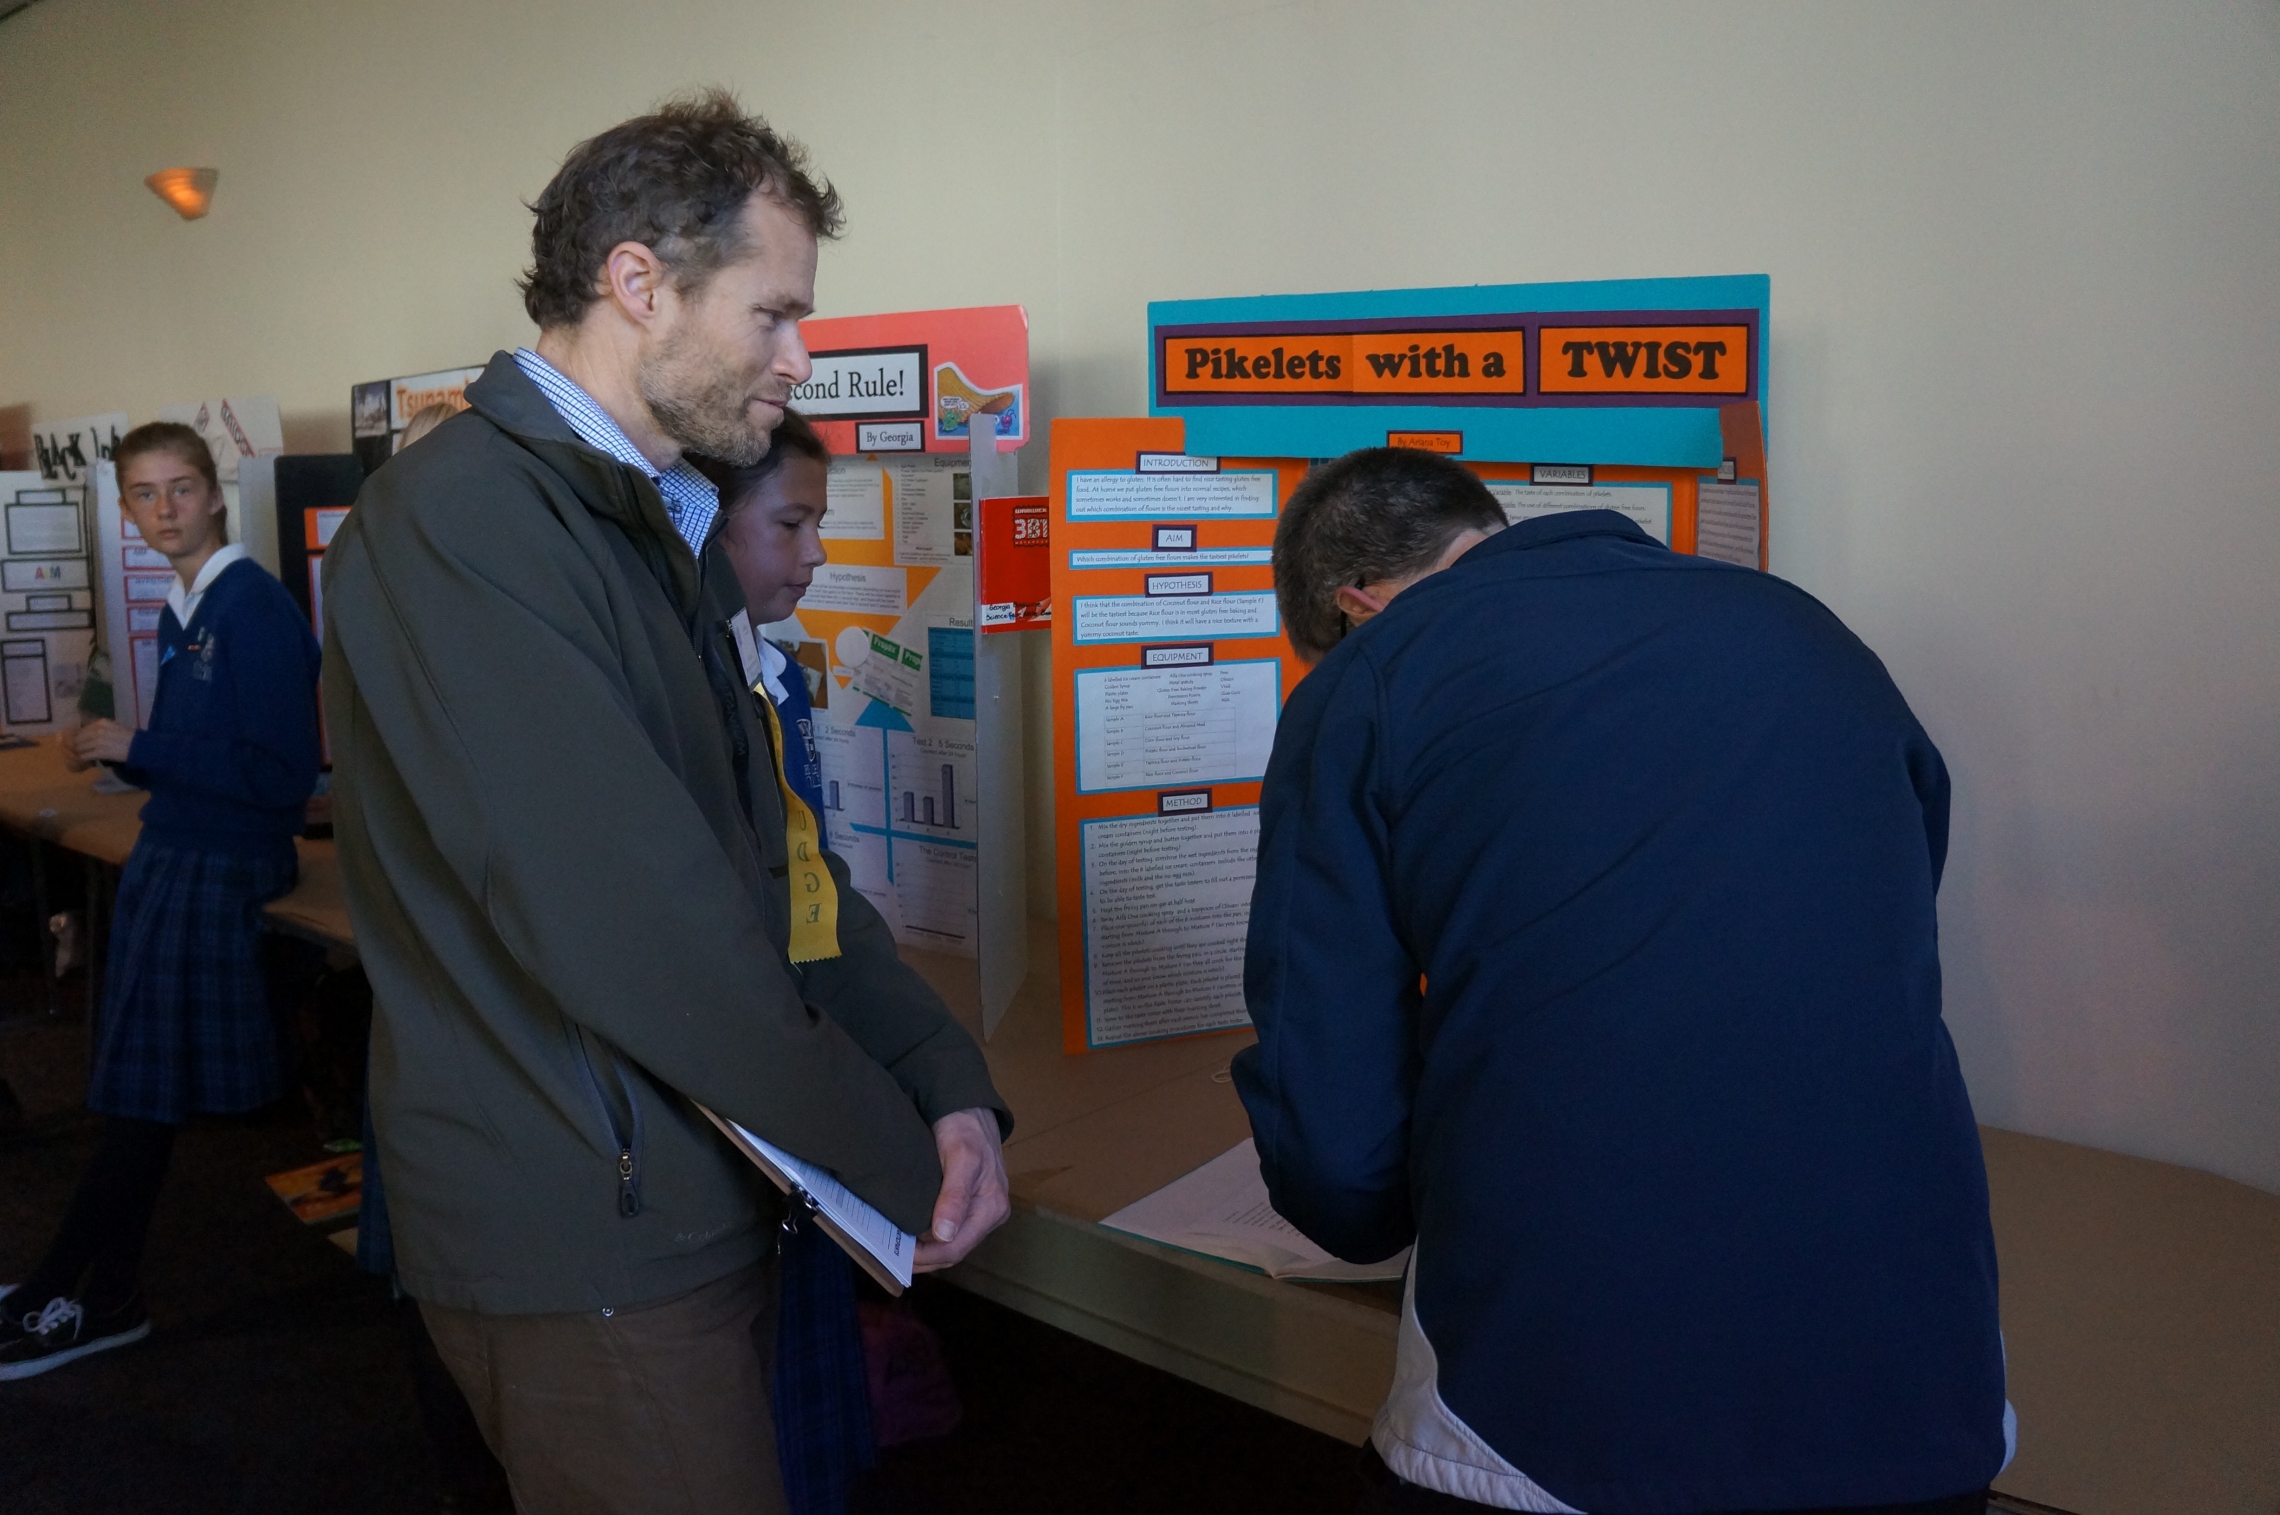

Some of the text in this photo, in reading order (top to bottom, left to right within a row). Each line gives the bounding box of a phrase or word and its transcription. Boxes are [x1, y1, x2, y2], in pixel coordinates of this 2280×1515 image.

[1184, 340, 1728, 380] Pikelets with a TWIST
[790, 367, 904, 400] cond Rule!
[866, 431, 914, 445] By Georgia
[1397, 437, 1451, 450] By Ariana Toy
[1143, 457, 1209, 467] INTRODUCTION
[1539, 468, 1586, 480] VARIABLES
[1101, 476, 1119, 485] allergy
[1215, 476, 1233, 484] tasting
[1240, 494, 1259, 503] finding
[1192, 505, 1210, 513] tasting
[1165, 534, 1183, 543] AIM
[34, 565, 61, 580] AIM
[829, 572, 867, 584] Hypothesis
[1152, 580, 1203, 590] HYPOTHESIS
[1152, 652, 1203, 662] EQUIPMENT
[912, 736, 927, 746] Test
[944, 740, 975, 751] Seconds
[1165, 797, 1202, 807] METHOD
